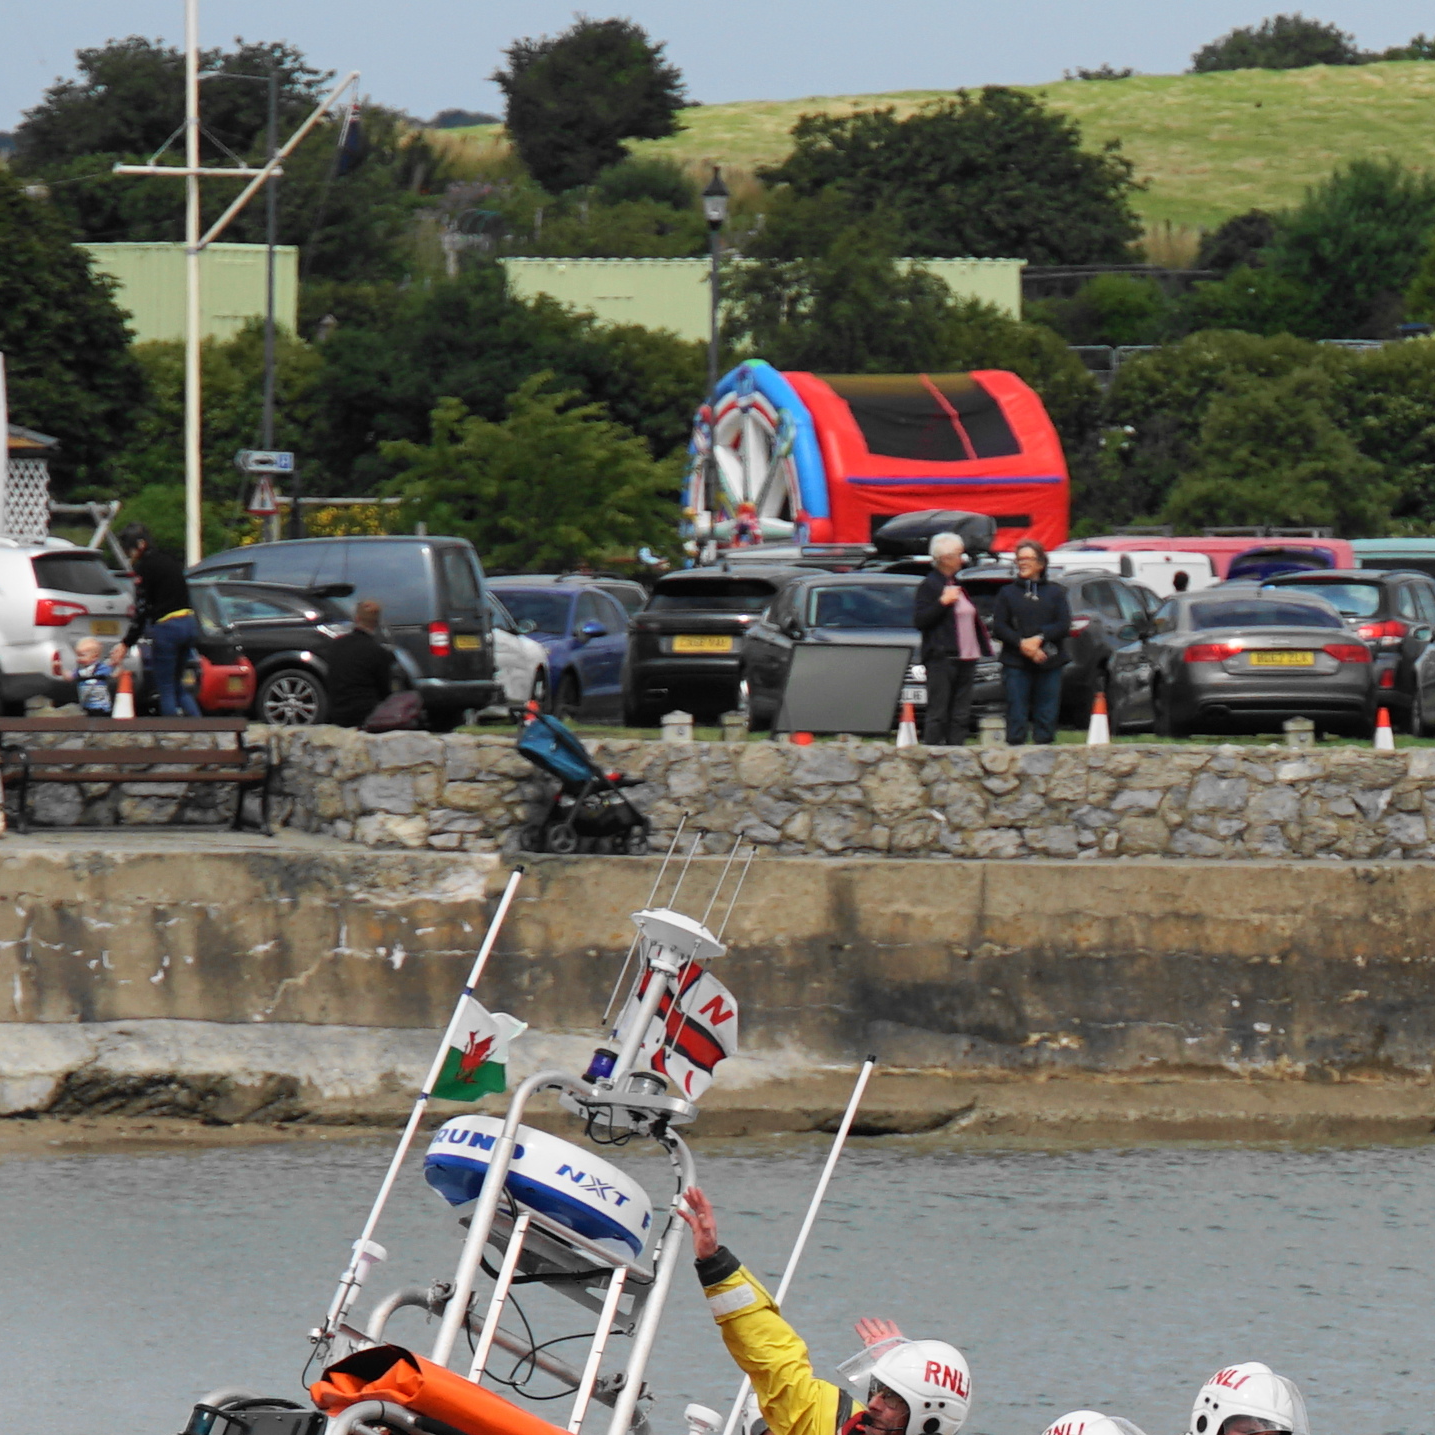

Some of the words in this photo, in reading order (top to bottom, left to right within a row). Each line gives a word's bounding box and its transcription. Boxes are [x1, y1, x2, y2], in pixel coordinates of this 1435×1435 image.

[555, 1164, 630, 1207] NXT
[924, 1360, 970, 1401] RNLI
[1205, 1369, 1251, 1391] NLI
